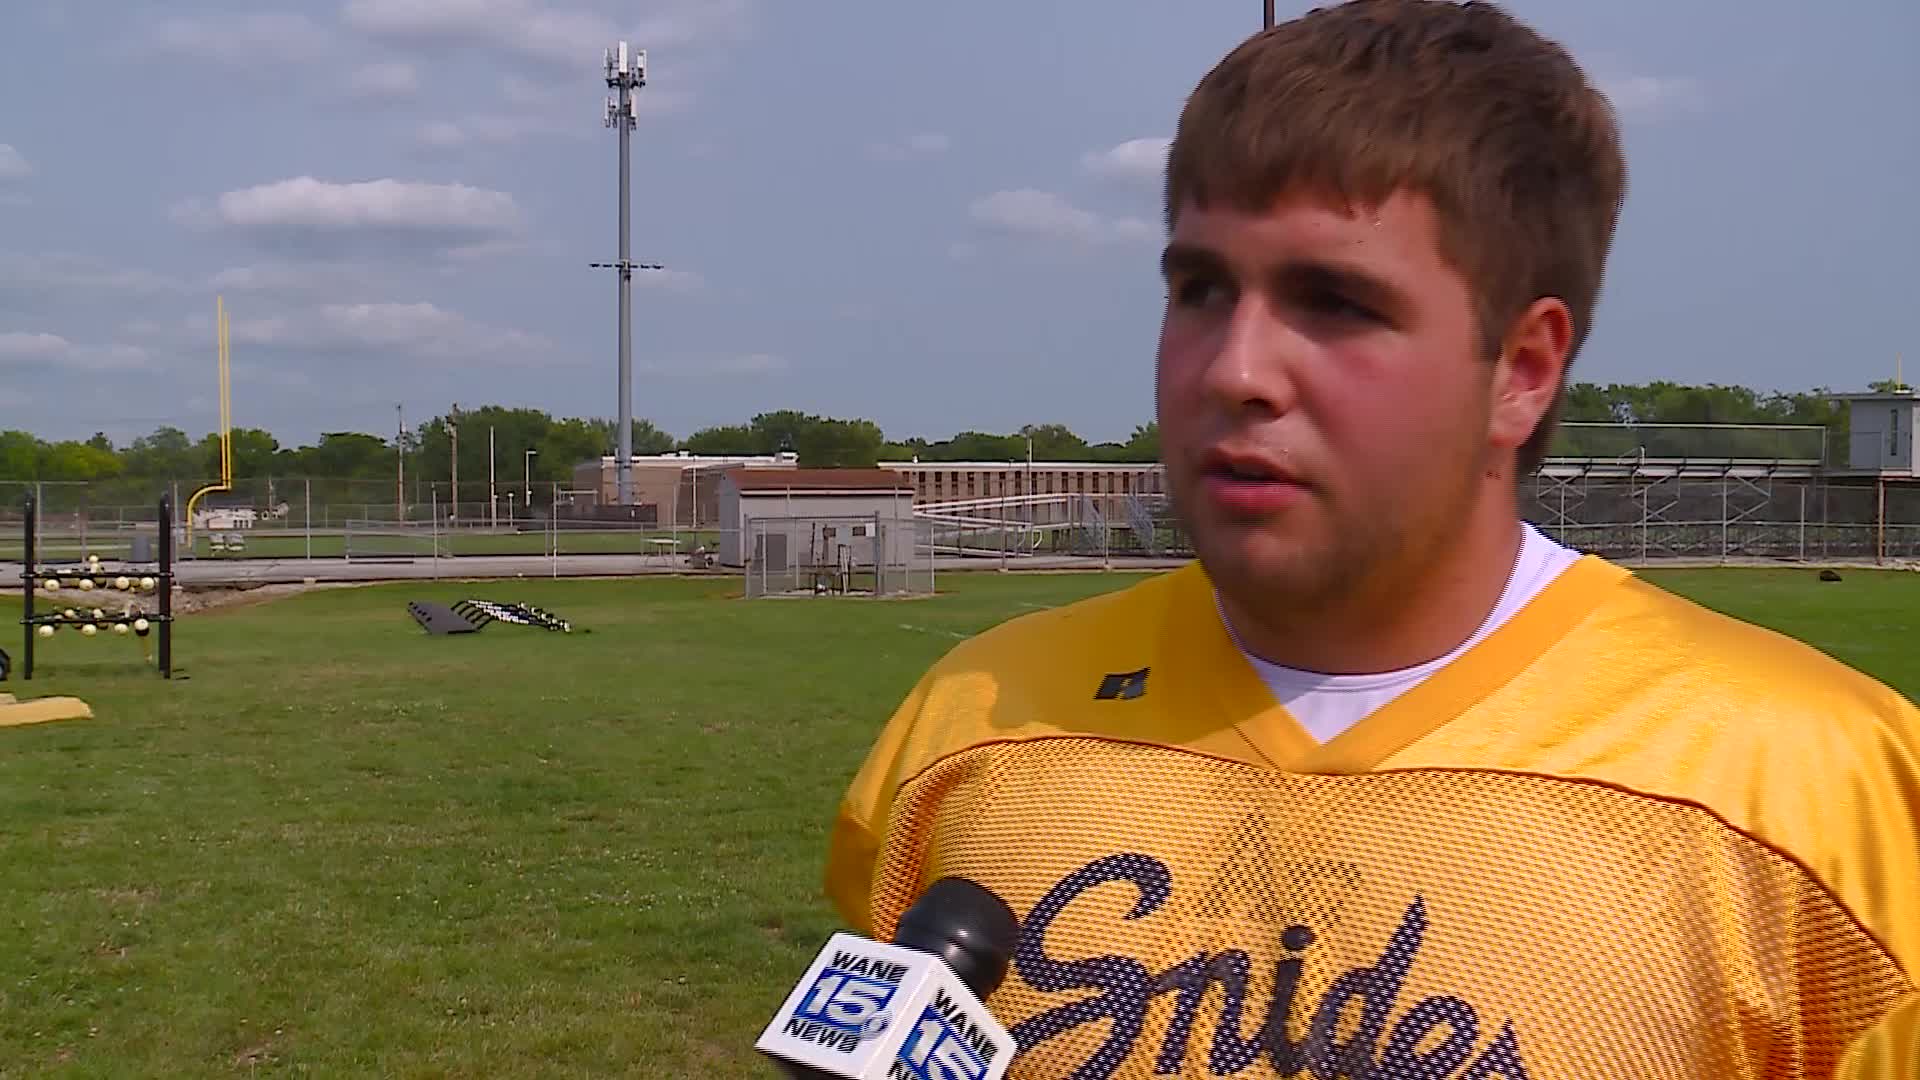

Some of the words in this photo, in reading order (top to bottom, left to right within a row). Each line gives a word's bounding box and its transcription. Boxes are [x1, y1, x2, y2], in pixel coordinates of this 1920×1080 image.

[831, 950, 910, 984] WANE
[803, 974, 895, 1027] 15
[782, 1017, 861, 1054] NEWS
[934, 987, 998, 1064] WANE
